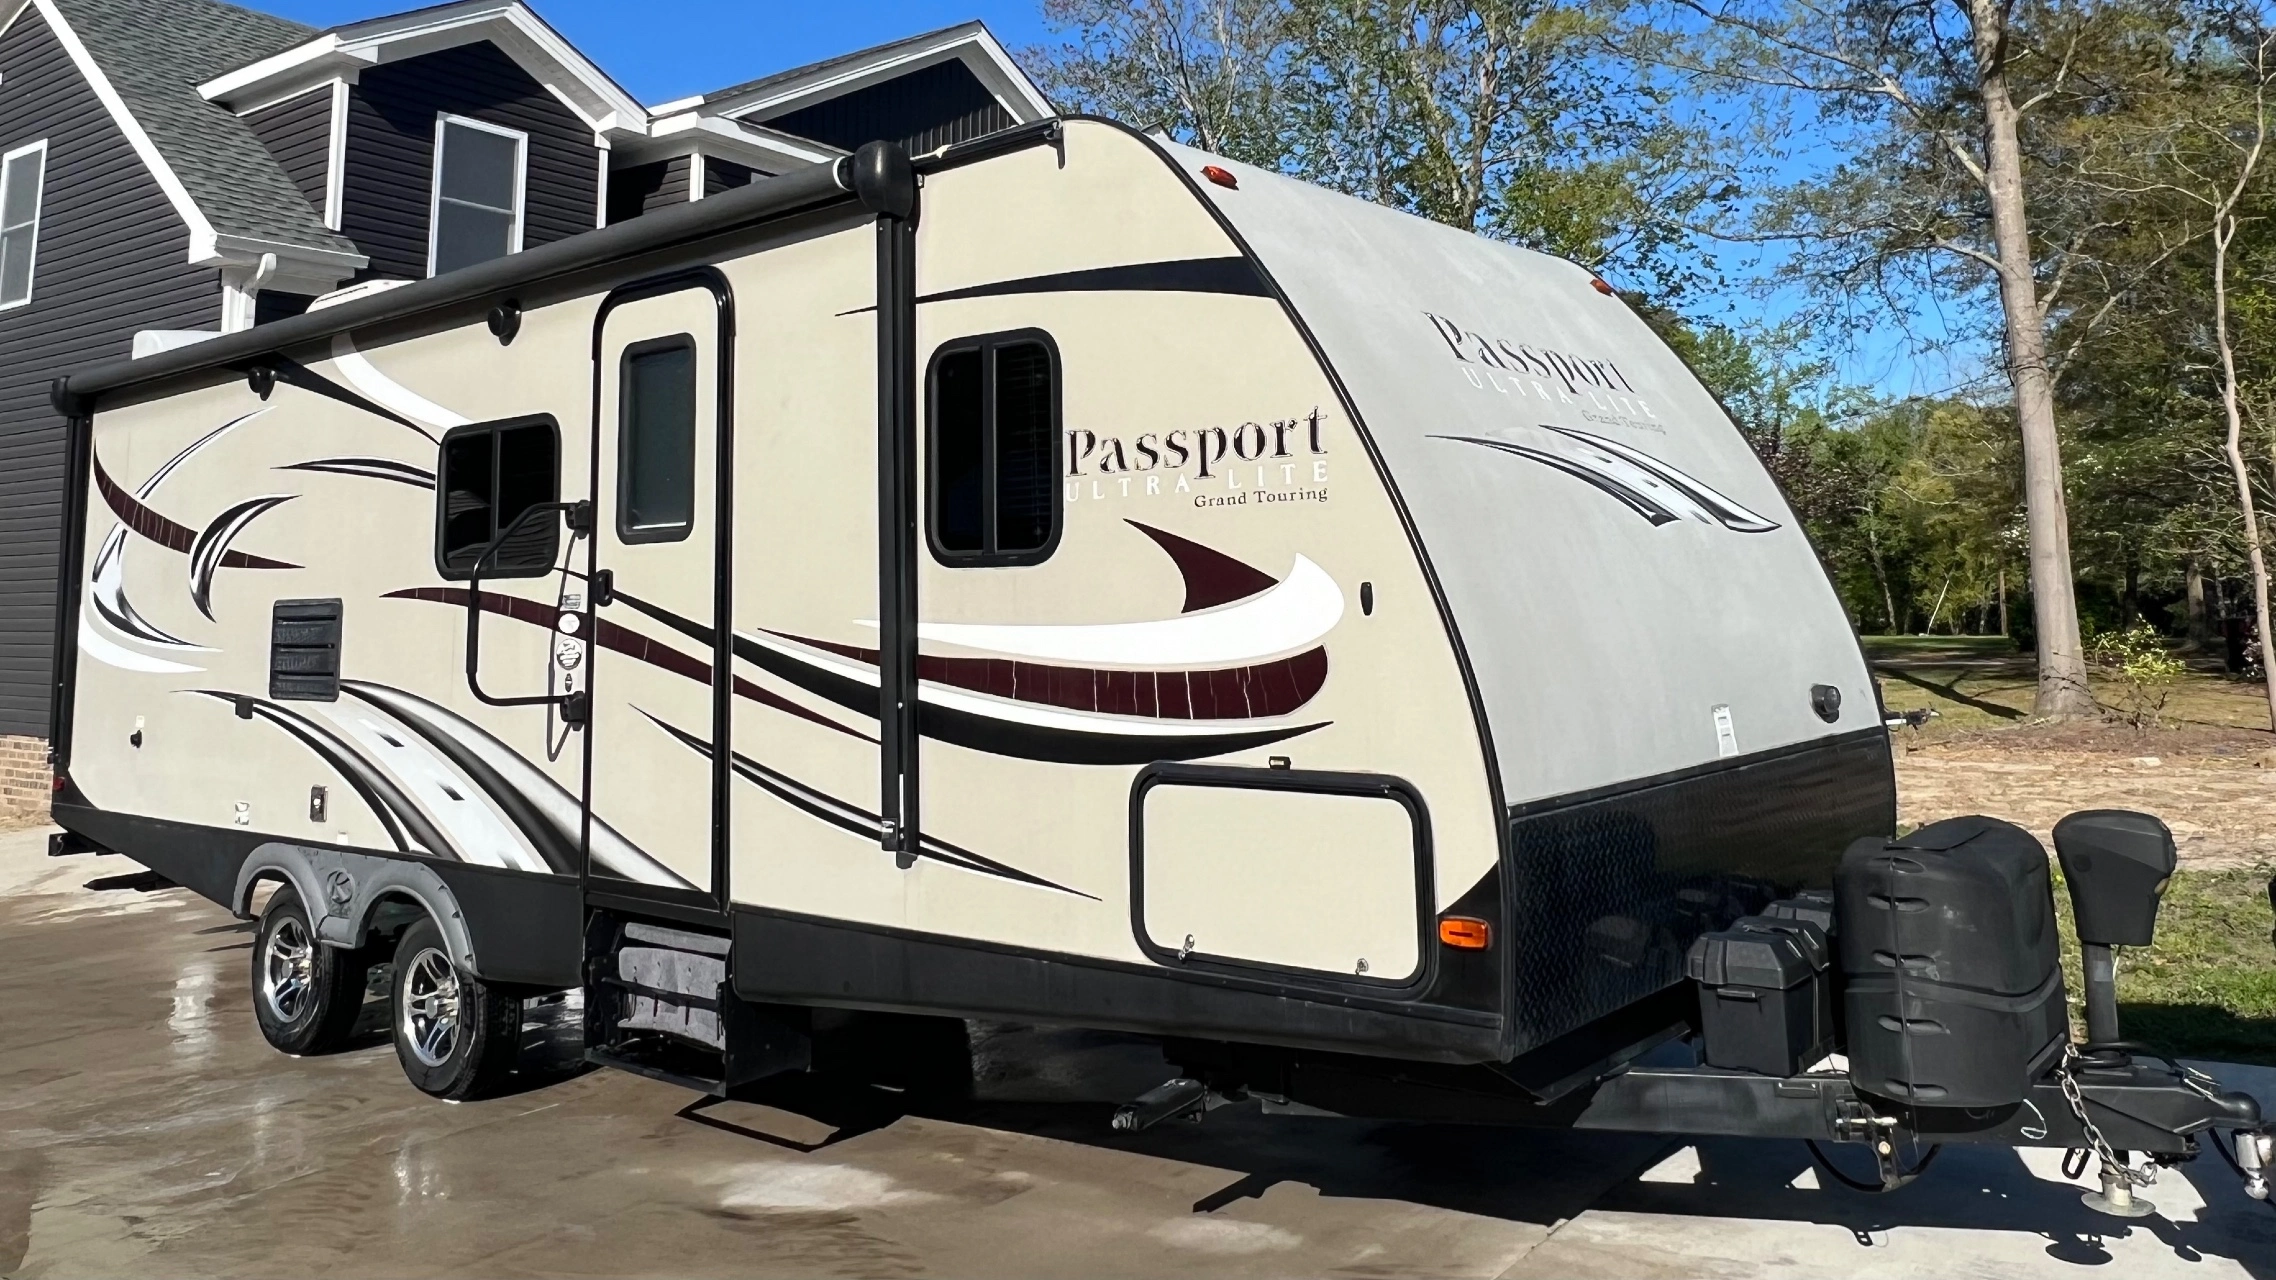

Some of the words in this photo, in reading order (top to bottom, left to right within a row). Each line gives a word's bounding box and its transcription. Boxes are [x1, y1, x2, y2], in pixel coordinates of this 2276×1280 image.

[1421, 311, 1635, 396] Passport
[1460, 366, 1574, 406] ULTRA
[1588, 390, 1656, 419] LITE
[1065, 405, 1328, 480] Passport
[1065, 472, 1191, 502] ULTRA
[1228, 460, 1328, 491] LITE
[1194, 492, 1247, 508] Grand
[1254, 487, 1328, 504] Touring
